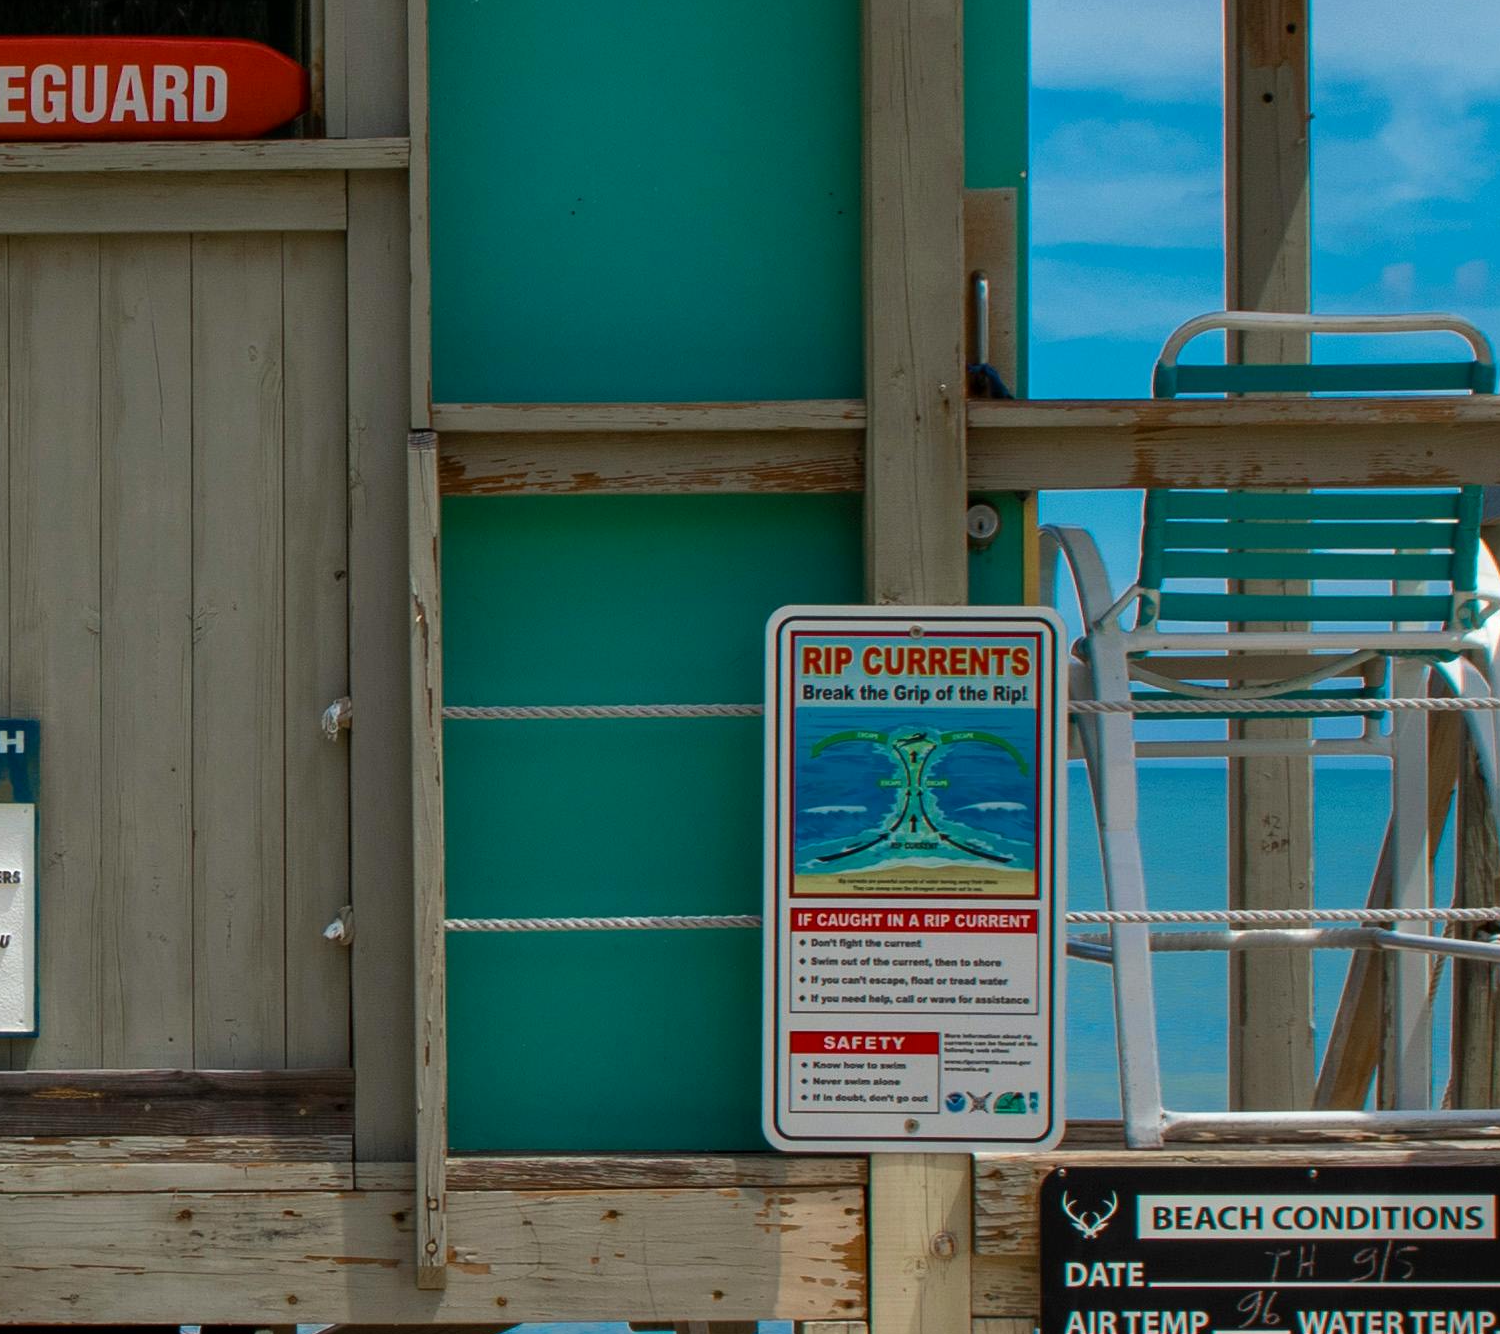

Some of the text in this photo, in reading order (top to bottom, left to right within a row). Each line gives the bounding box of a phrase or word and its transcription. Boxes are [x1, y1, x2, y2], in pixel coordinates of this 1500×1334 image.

[801, 645, 1031, 677] RIP CURRENTS
[802, 684, 1029, 706] Break the Grip of the Rip!
[797, 913, 1031, 928] IF CAUGHT IN A RIP CURRENT
[811, 938, 922, 950] Don't fight the current
[811, 957, 1002, 969] Swim out of the current, then to shore
[811, 976, 1009, 987] If you can't escape, float or tread water
[811, 995, 1030, 1006] If you need help, call or wave for assistance
[823, 1036, 906, 1050] SAFETY
[812, 1061, 907, 1069] Know how to swim
[812, 1077, 901, 1085] Never swim alone
[812, 1094, 820, 1102] If
[823, 1094, 833, 1102] in
[912, 1095, 929, 1103] out
[1152, 1205, 1484, 1231] BEACH CONDITIONS
[1065, 1261, 1145, 1288] DATE
[1236, 1290, 1281, 1329] 96
